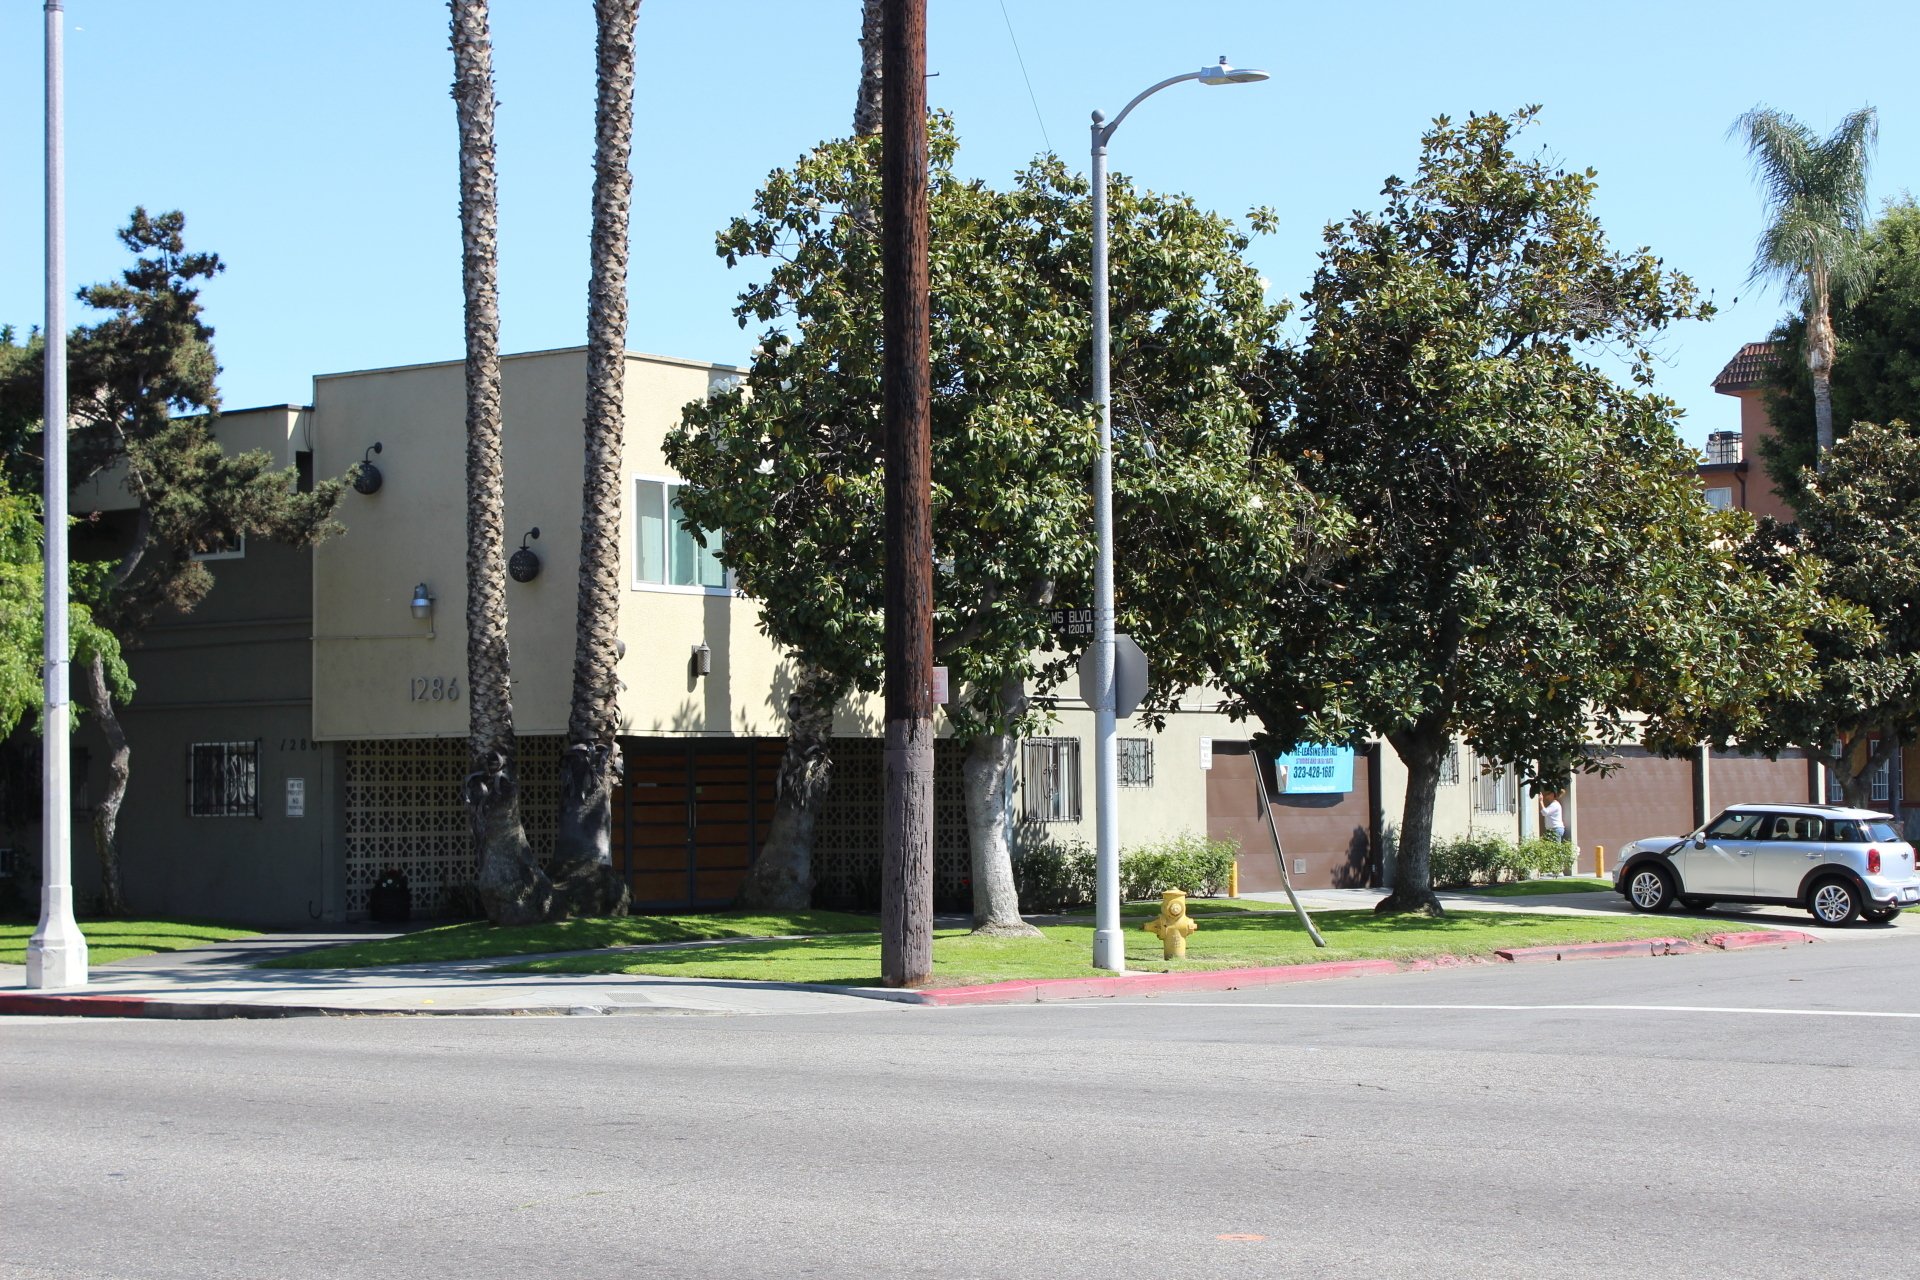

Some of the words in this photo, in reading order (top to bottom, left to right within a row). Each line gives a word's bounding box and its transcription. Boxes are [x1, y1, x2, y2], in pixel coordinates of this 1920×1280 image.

[1068, 610, 1093, 623] BLVD.
[1068, 624, 1085, 634] 1200
[1086, 623, 1094, 633] W.
[411, 676, 460, 702] 1286
[1293, 766, 1335, 778] 323-428-1687
